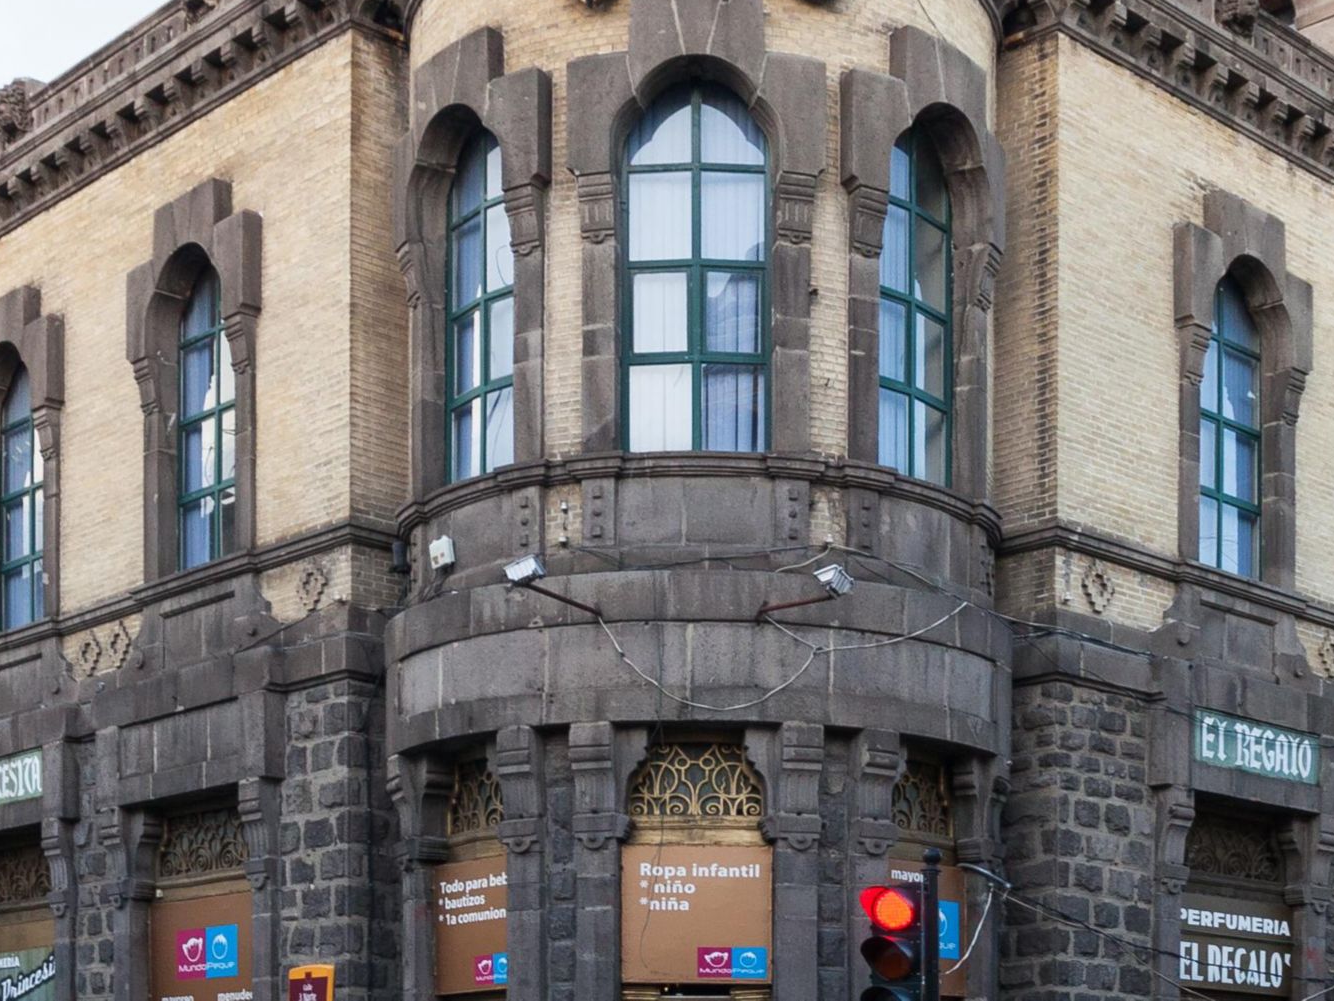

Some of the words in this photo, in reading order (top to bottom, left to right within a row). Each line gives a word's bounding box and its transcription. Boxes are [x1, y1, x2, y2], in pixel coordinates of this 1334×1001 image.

[1234, 722, 1312, 778] REGALO
[639, 863, 686, 878] Ropa
[692, 863, 760, 878] infantil
[440, 879, 464, 893] Todo
[465, 877, 487, 893] para
[654, 880, 695, 893] niño
[445, 895, 485, 909] bautizos
[649, 897, 689, 910] niña
[446, 914, 457, 925] 1a
[1180, 941, 1204, 981] EL
